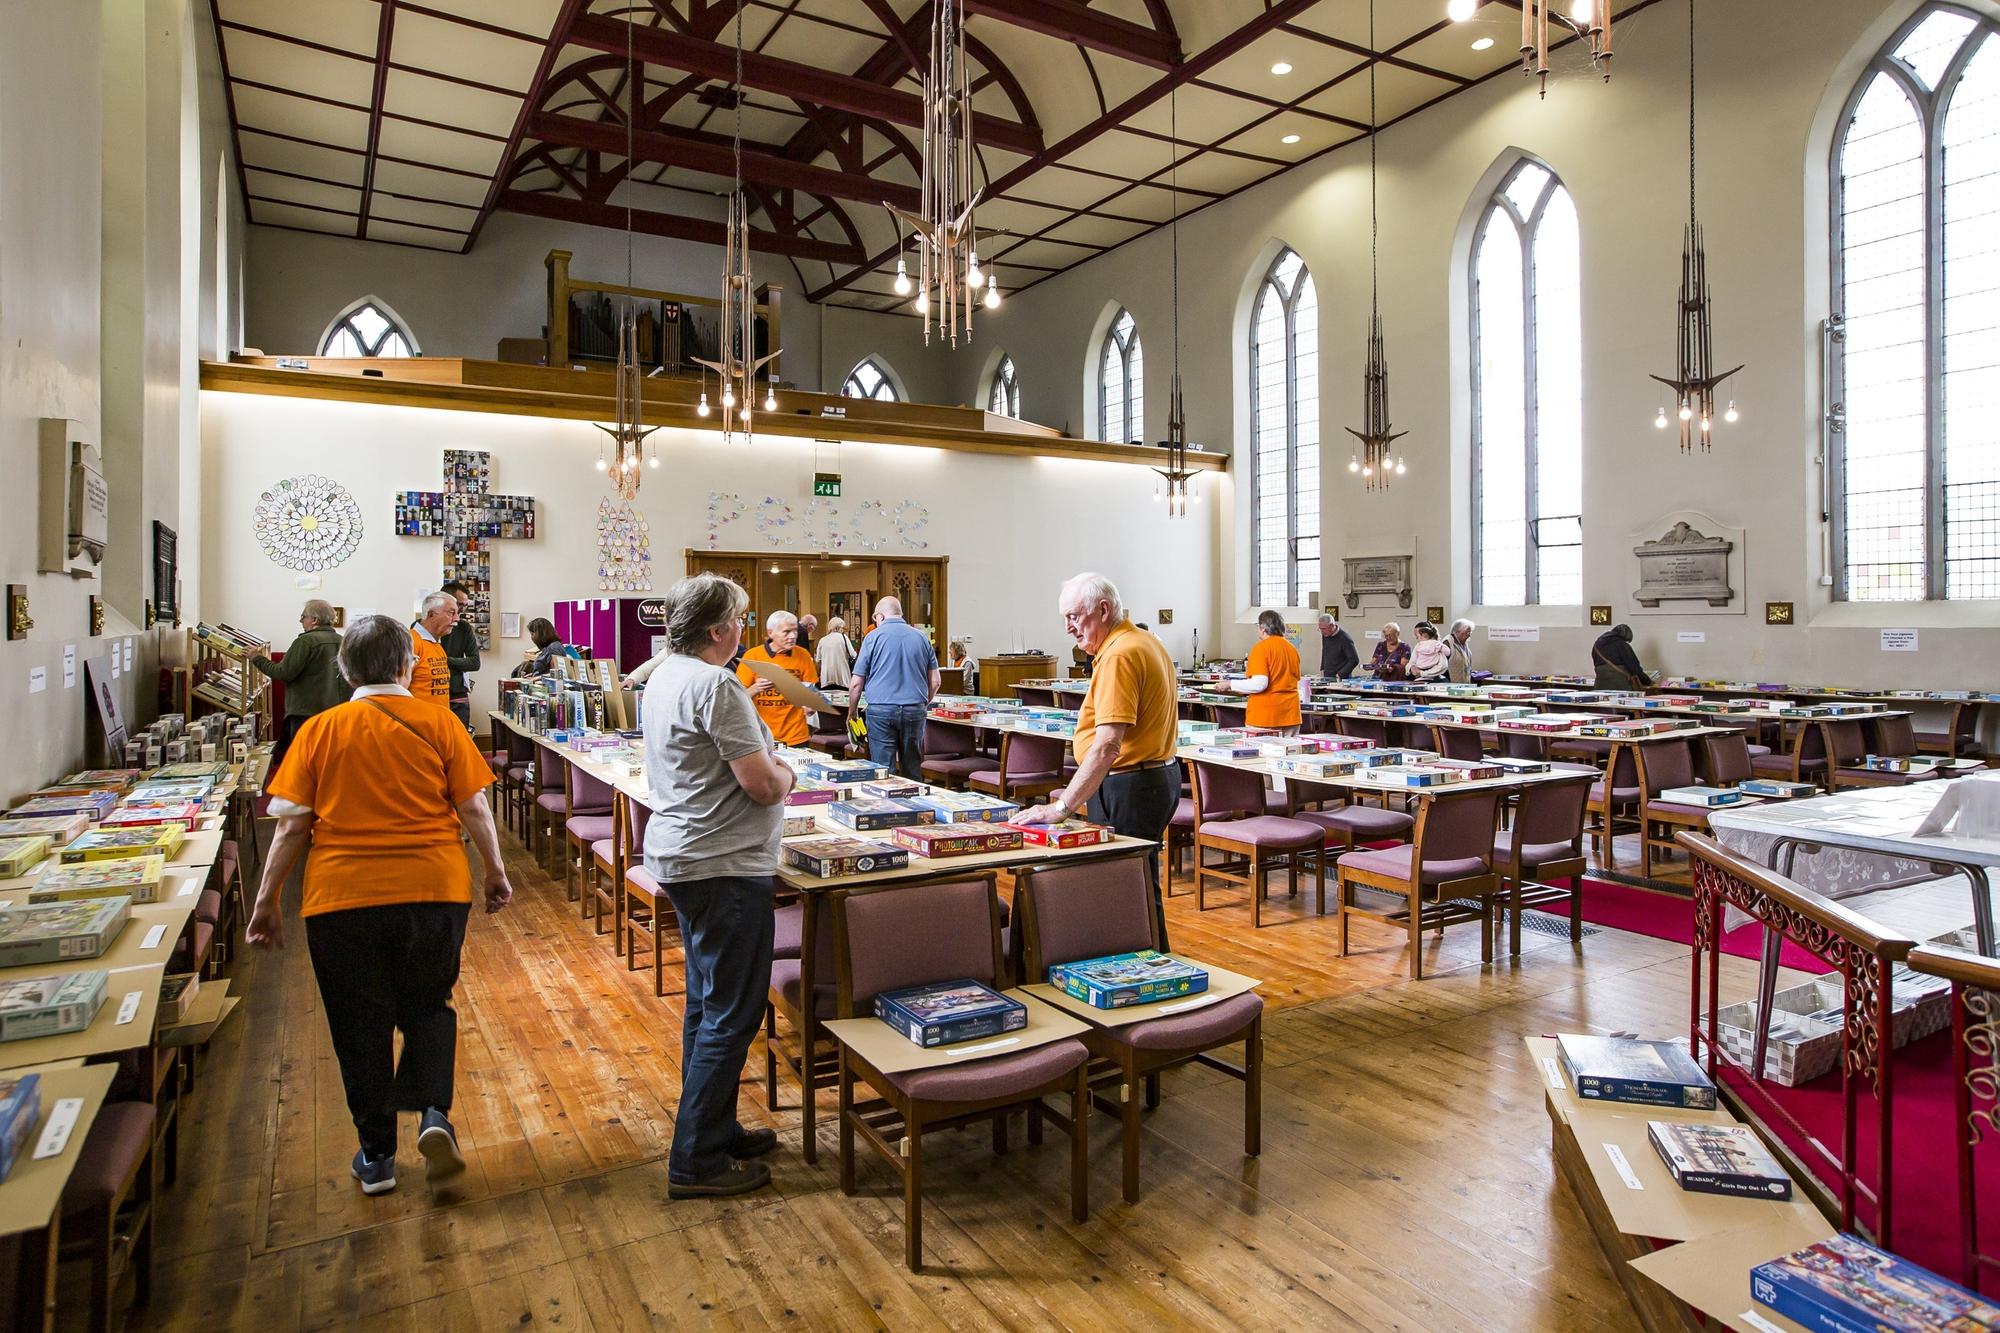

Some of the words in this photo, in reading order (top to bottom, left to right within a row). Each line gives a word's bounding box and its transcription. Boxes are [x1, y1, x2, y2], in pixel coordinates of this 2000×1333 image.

[797, 758, 814, 766] 1000
[891, 855, 908, 864] 1000
[1139, 984, 1154, 993] 1000
[1583, 1079, 1600, 1087] 1000
